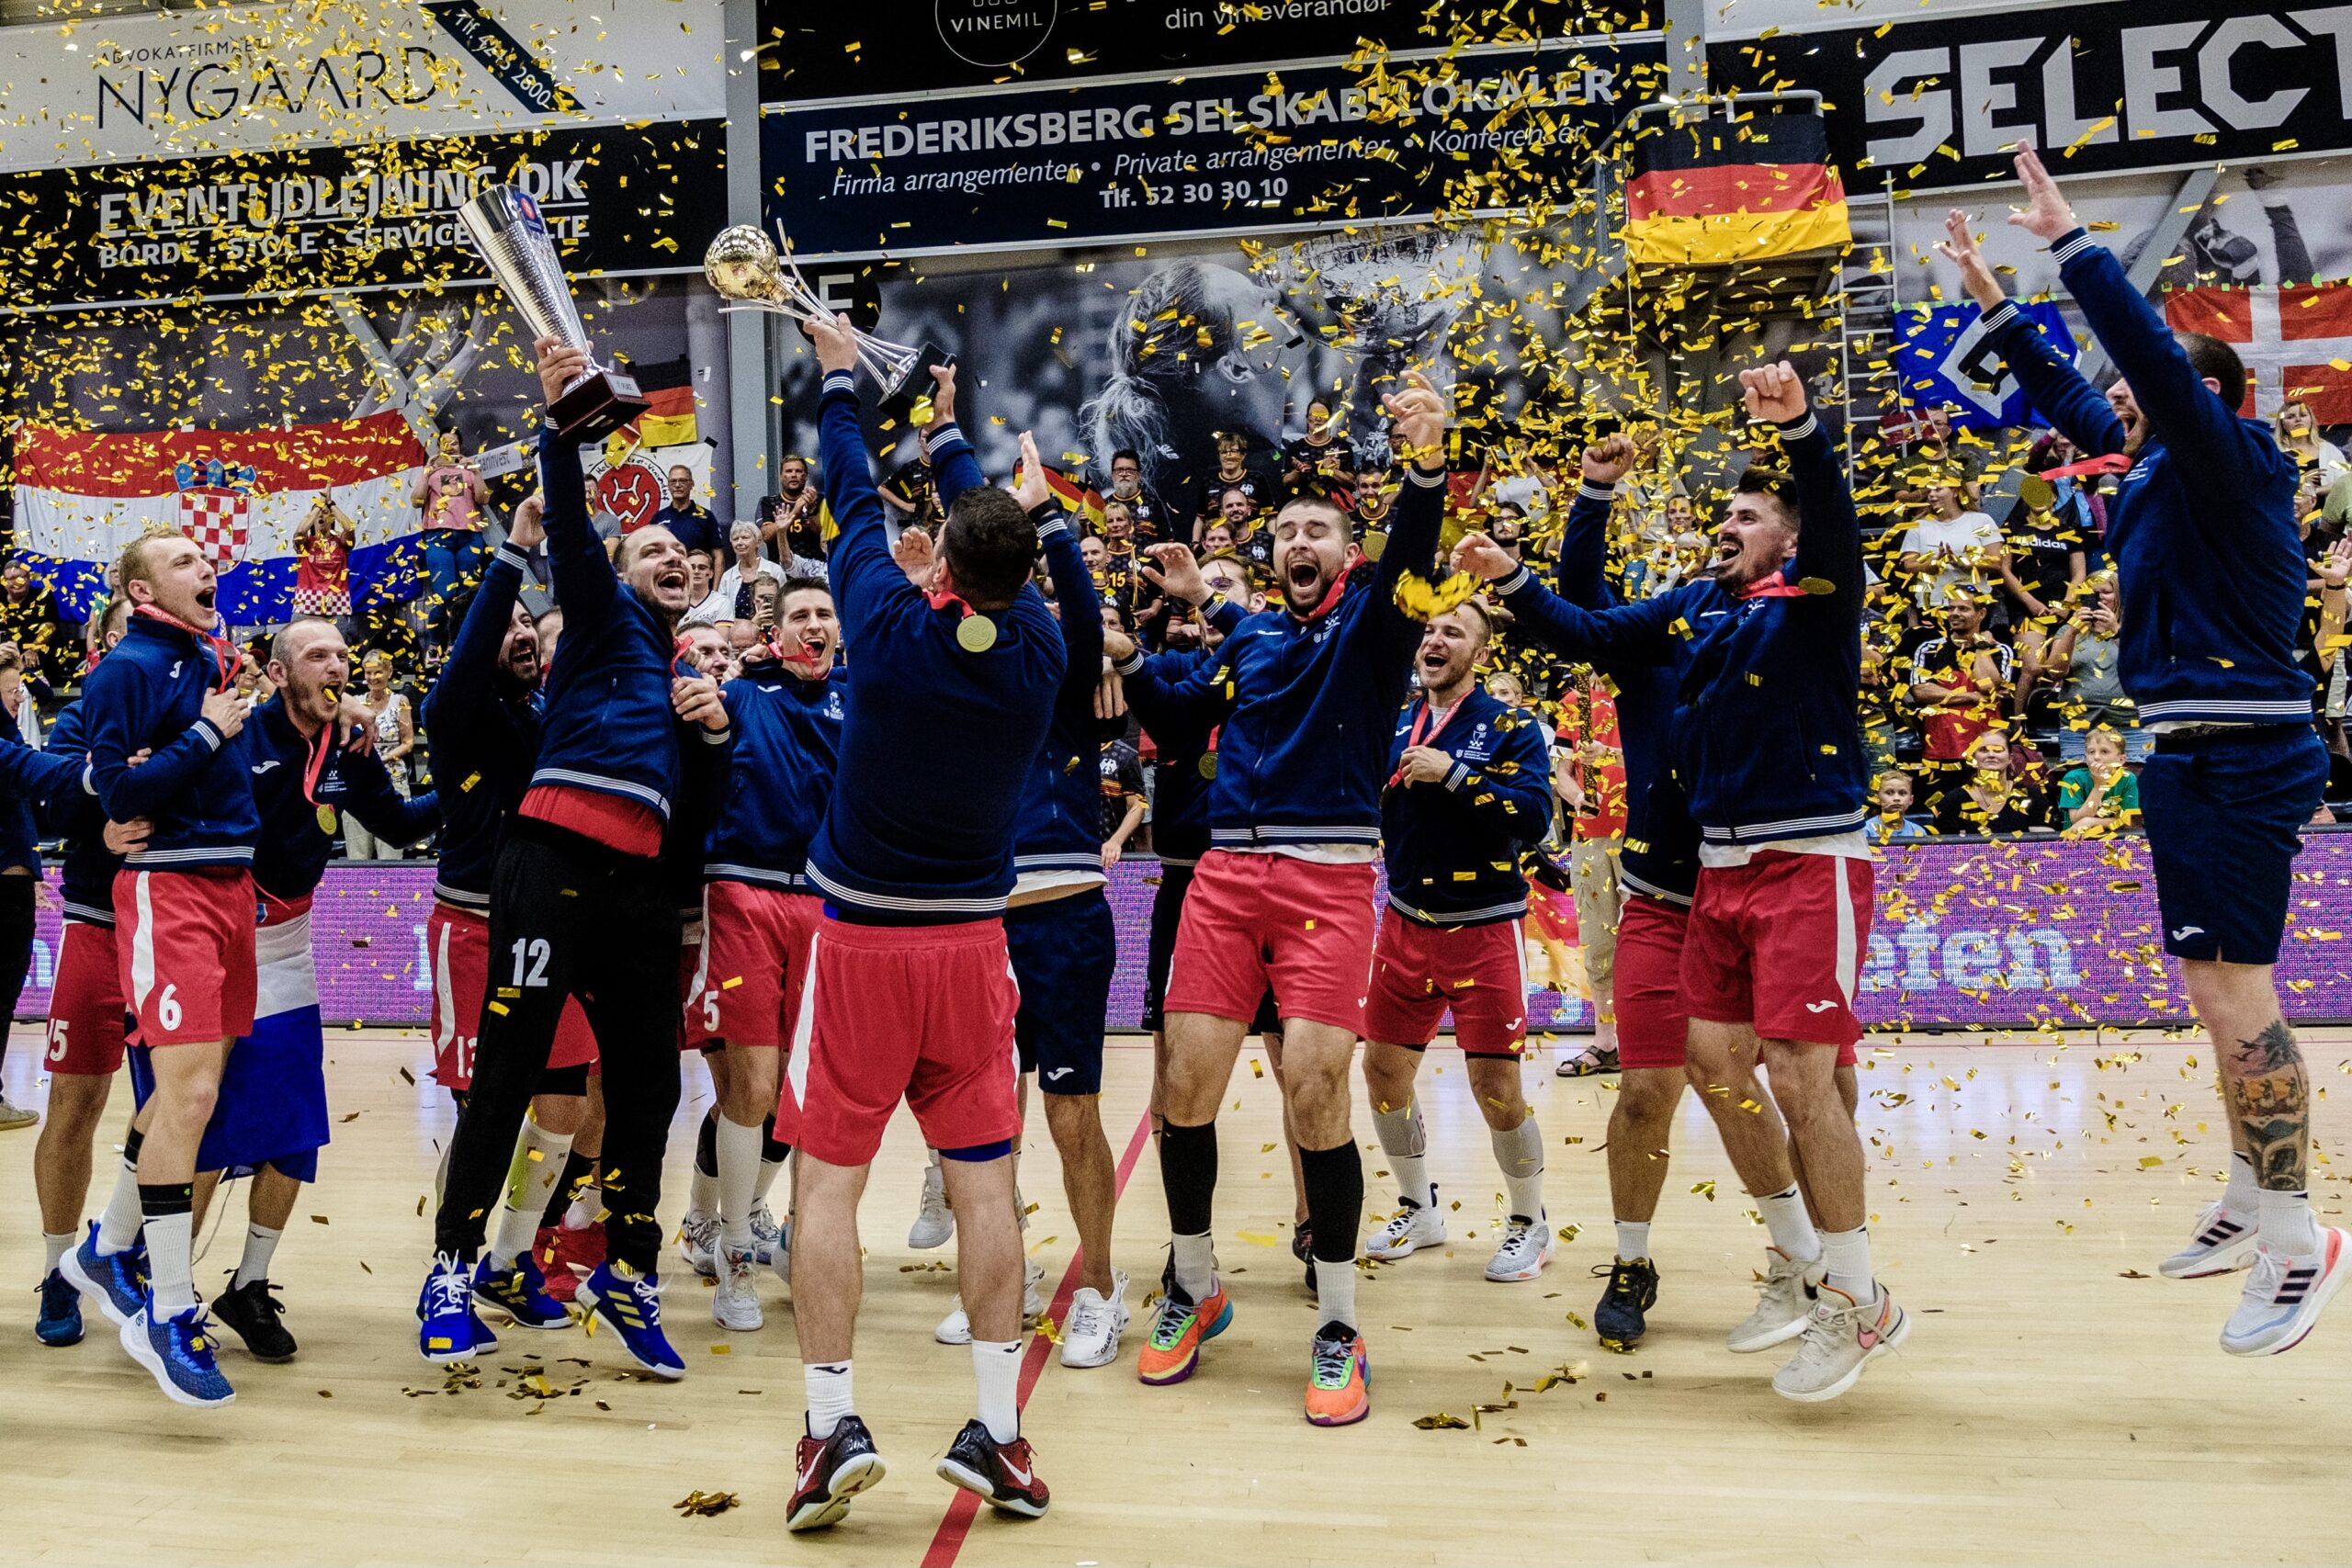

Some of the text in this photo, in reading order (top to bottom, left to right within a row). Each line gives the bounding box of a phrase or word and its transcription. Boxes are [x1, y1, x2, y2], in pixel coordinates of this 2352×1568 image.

[950, 12, 1043, 33] VINEMIL
[1165, 8, 1204, 28] din
[99, 47, 437, 130] NYGAARD
[1864, 6, 2352, 166] SELECT
[805, 68, 1614, 163] FREDERIKSBERG SELSKABLOKALER
[832, 174, 896, 197] Firma
[905, 160, 1079, 193] arrangementer
[1114, 150, 1197, 176] Private
[1206, 136, 1391, 171] arrangementer
[1100, 177, 1288, 209] Tlf. 52 30 30 10
[2019, 536, 2067, 550] didas
[1109, 571, 1126, 588] 15
[512, 938, 551, 987] 12
[159, 983, 183, 1032] 6
[703, 989, 720, 1032] 5
